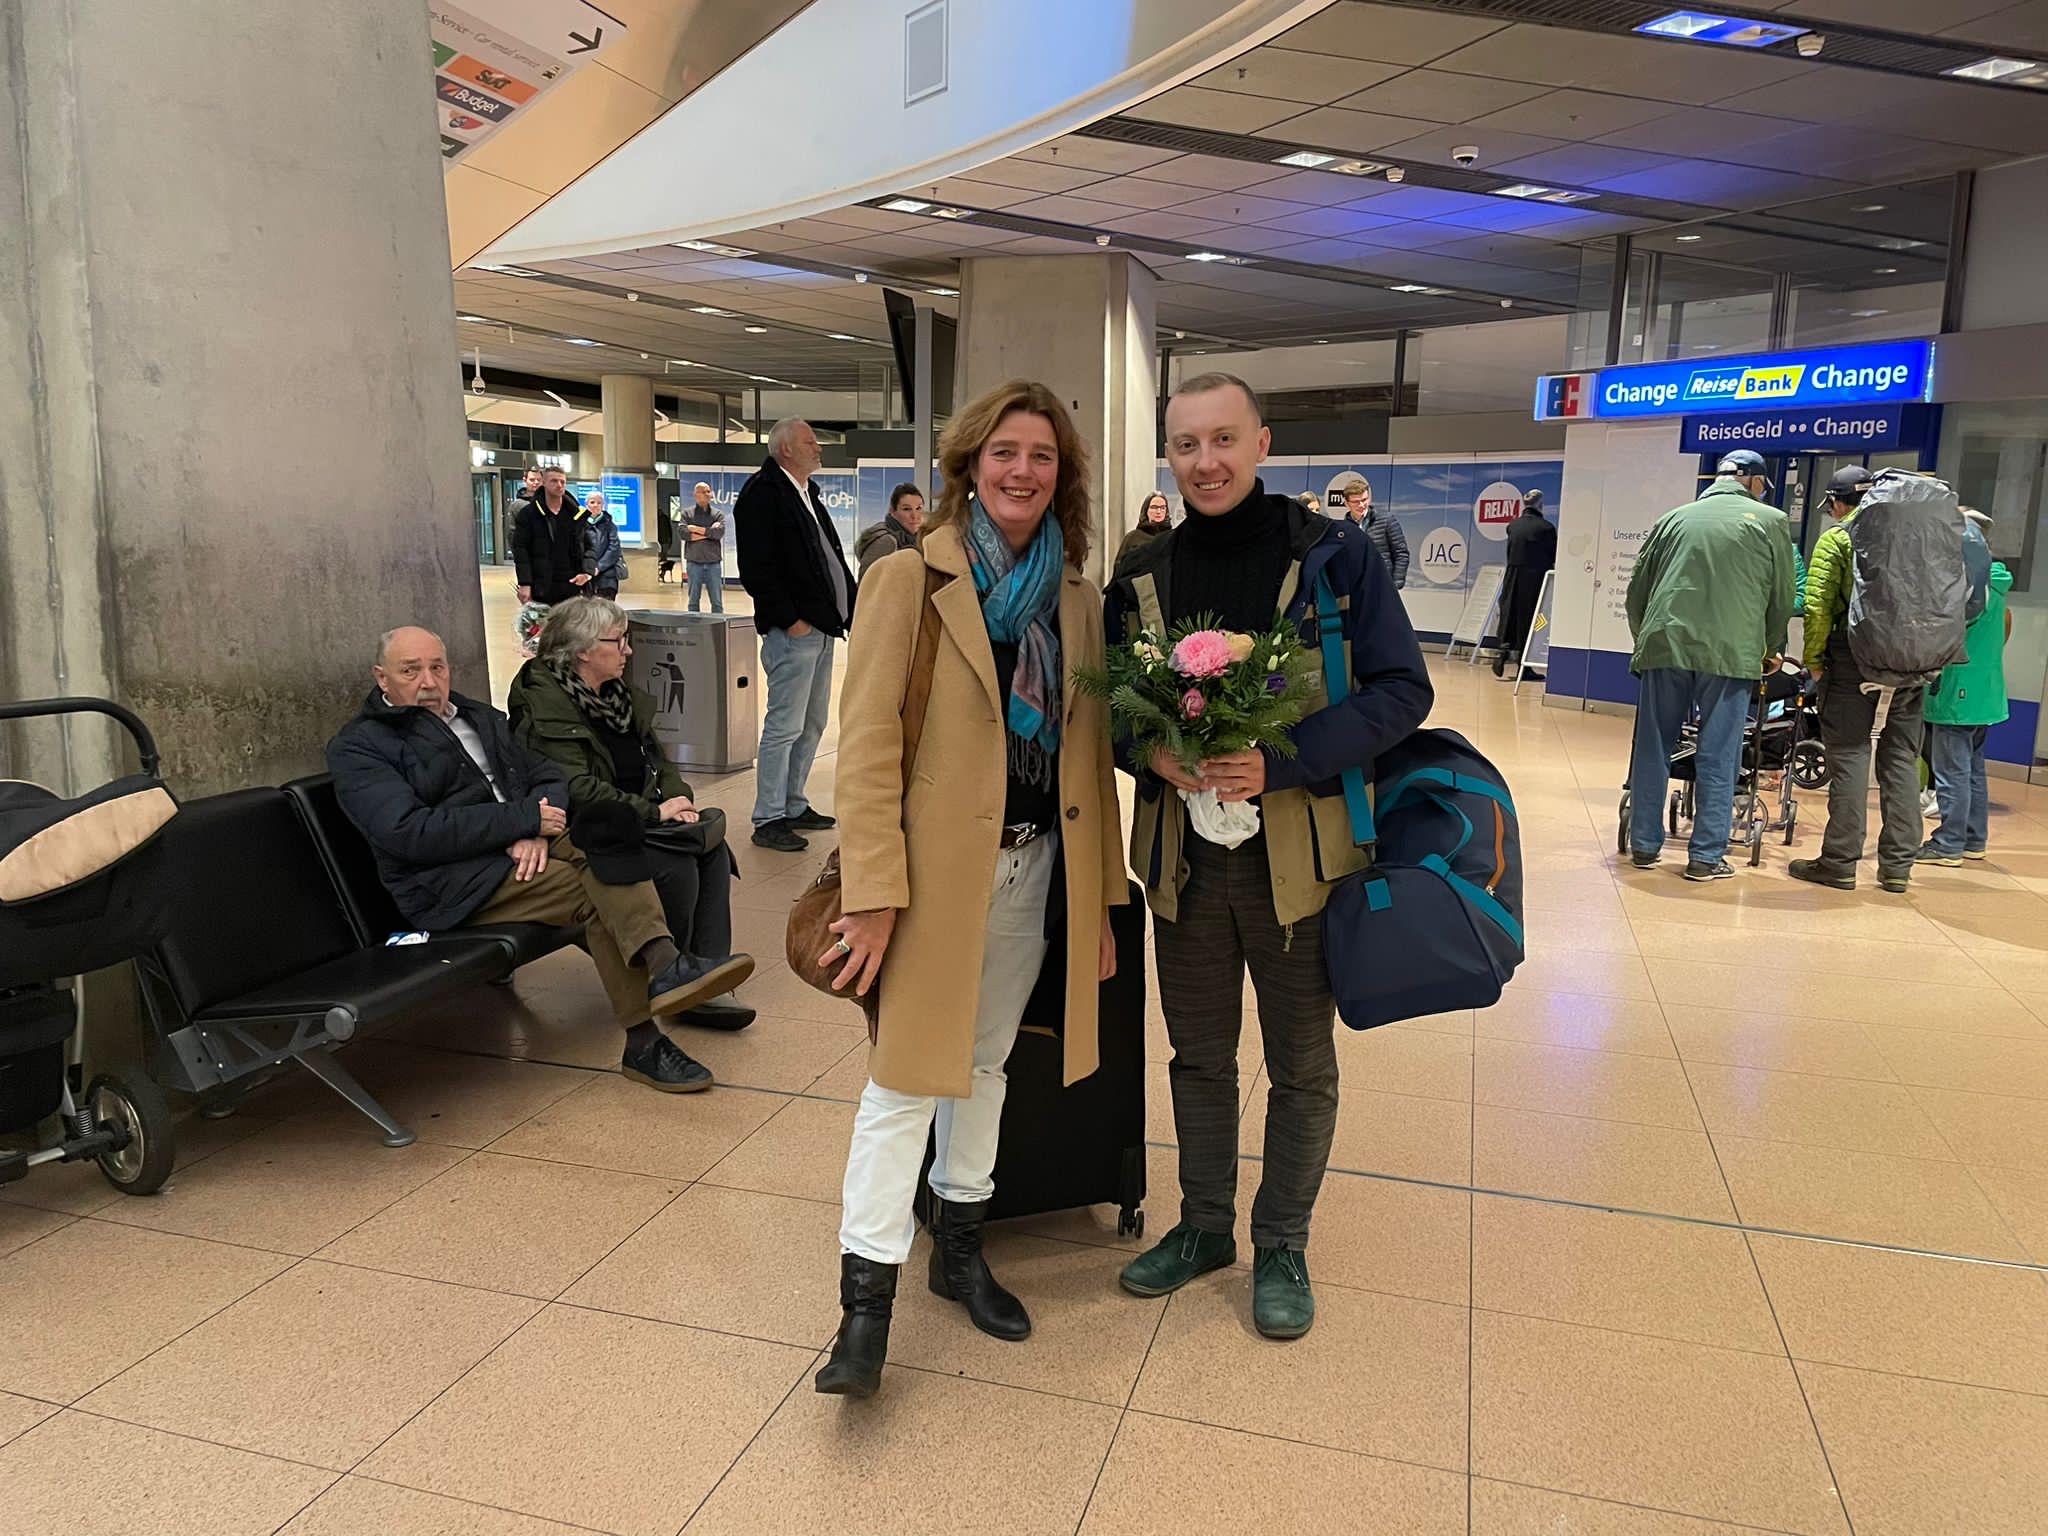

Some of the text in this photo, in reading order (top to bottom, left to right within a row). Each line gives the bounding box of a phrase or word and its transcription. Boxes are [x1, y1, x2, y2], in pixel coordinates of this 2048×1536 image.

[473, 32, 492, 44] Car
[455, 88, 500, 113] Budget
[1605, 382, 1679, 406] Change
[1811, 363, 1909, 391] Change
[1698, 417, 1888, 441] ReiseGeld Change
[1484, 500, 1516, 519] RELAY
[1613, 530, 1649, 541] Unsere S
[1424, 544, 1462, 563] JAC
